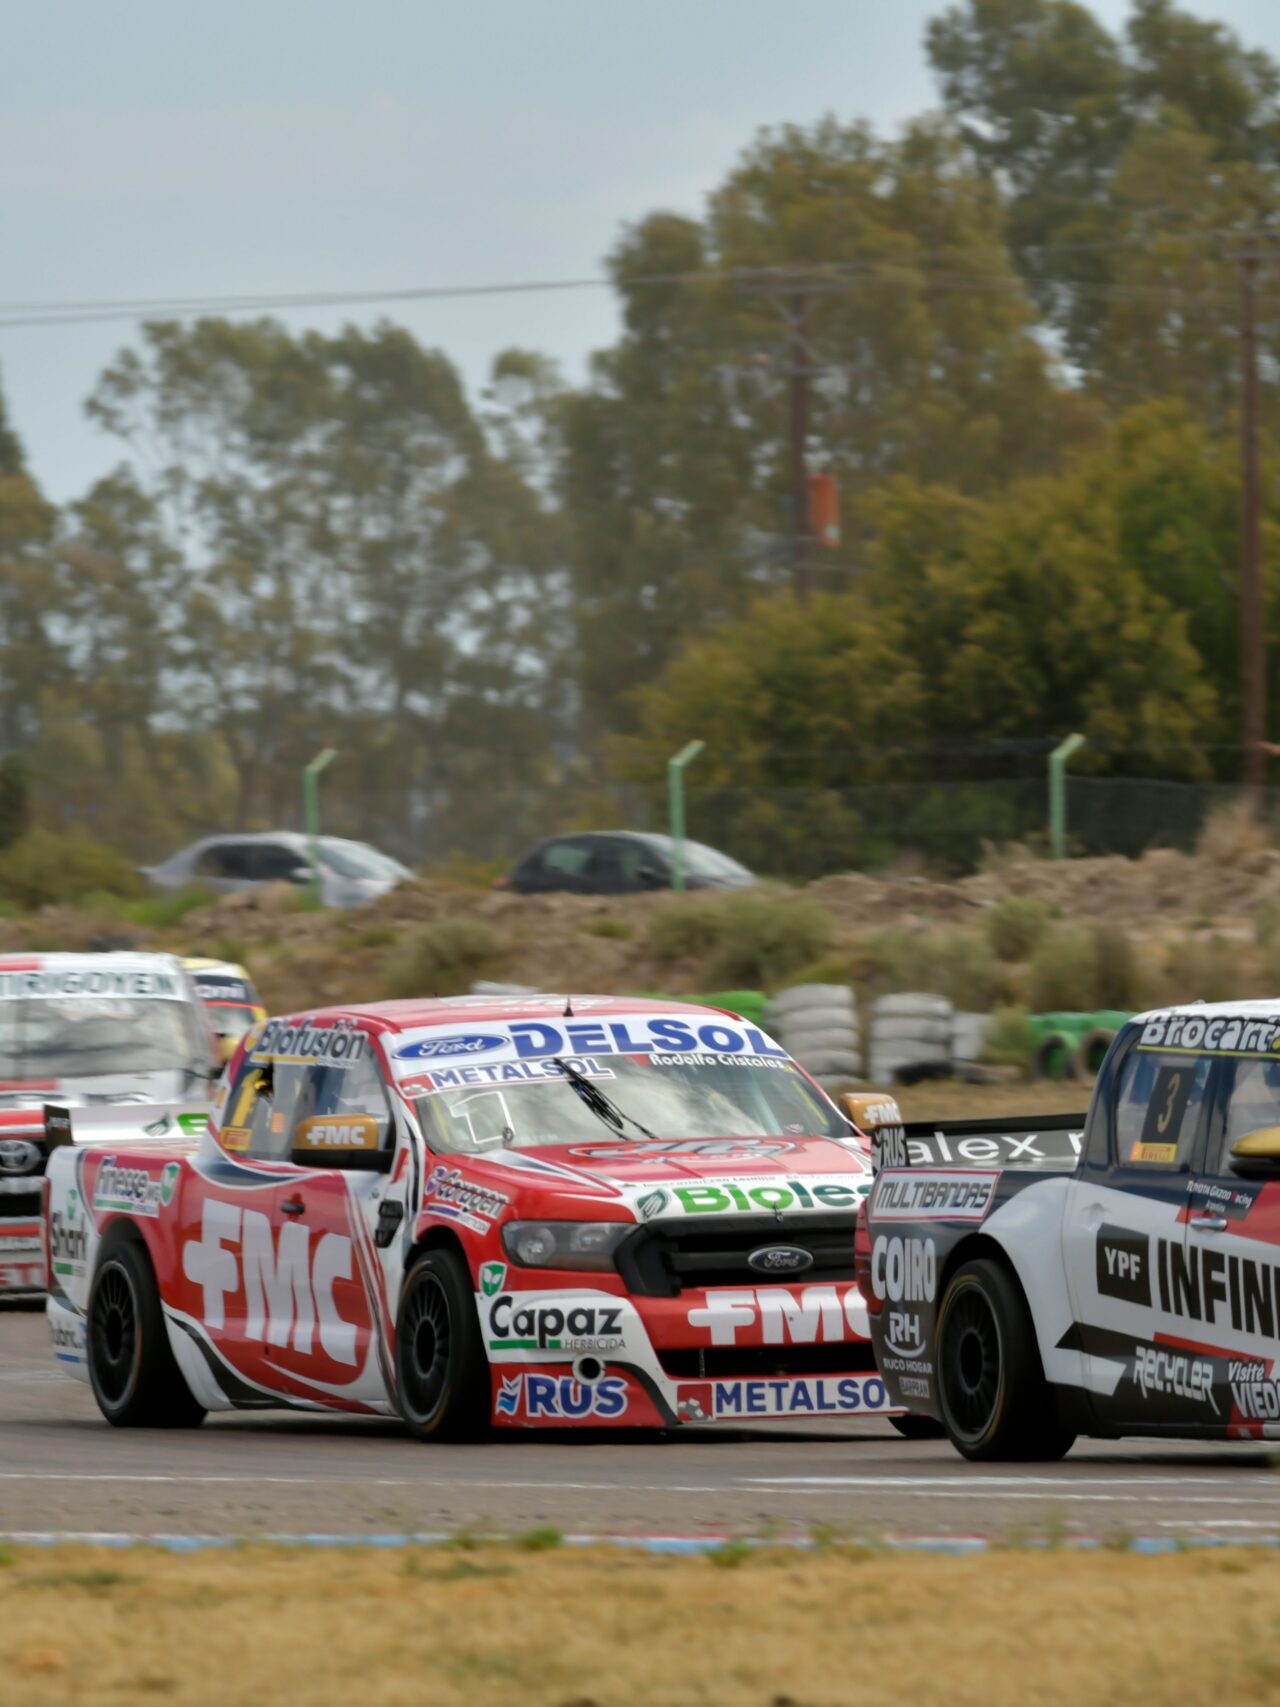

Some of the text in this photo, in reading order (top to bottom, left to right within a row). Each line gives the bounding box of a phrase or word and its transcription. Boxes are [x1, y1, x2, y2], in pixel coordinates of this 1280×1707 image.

[418, 1037, 486, 1057] Ford
[507, 1018, 788, 1058] DELSOL
[1140, 1012, 1276, 1053] Brocart
[428, 1056, 613, 1088] METALSOL
[648, 1053, 717, 1068] Rodolfo
[1156, 1073, 1181, 1133] 3
[306, 1125, 367, 1147] FMC
[876, 1182, 992, 1209] MULTIBANDAS
[763, 1250, 800, 1267] Ford
[871, 1234, 936, 1303] COIRO
[1104, 1246, 1141, 1281] YPF
[183, 1199, 358, 1366] FMC
[489, 1296, 622, 1349] Capaz
[889, 1312, 920, 1346] RH
[565, 1338, 626, 1349] HERBICIDA
[906, 1360, 933, 1374] HOGAR
[1228, 1362, 1265, 1381] Visite
[527, 1374, 627, 1416] RUS
[716, 1378, 895, 1412] METALSO
